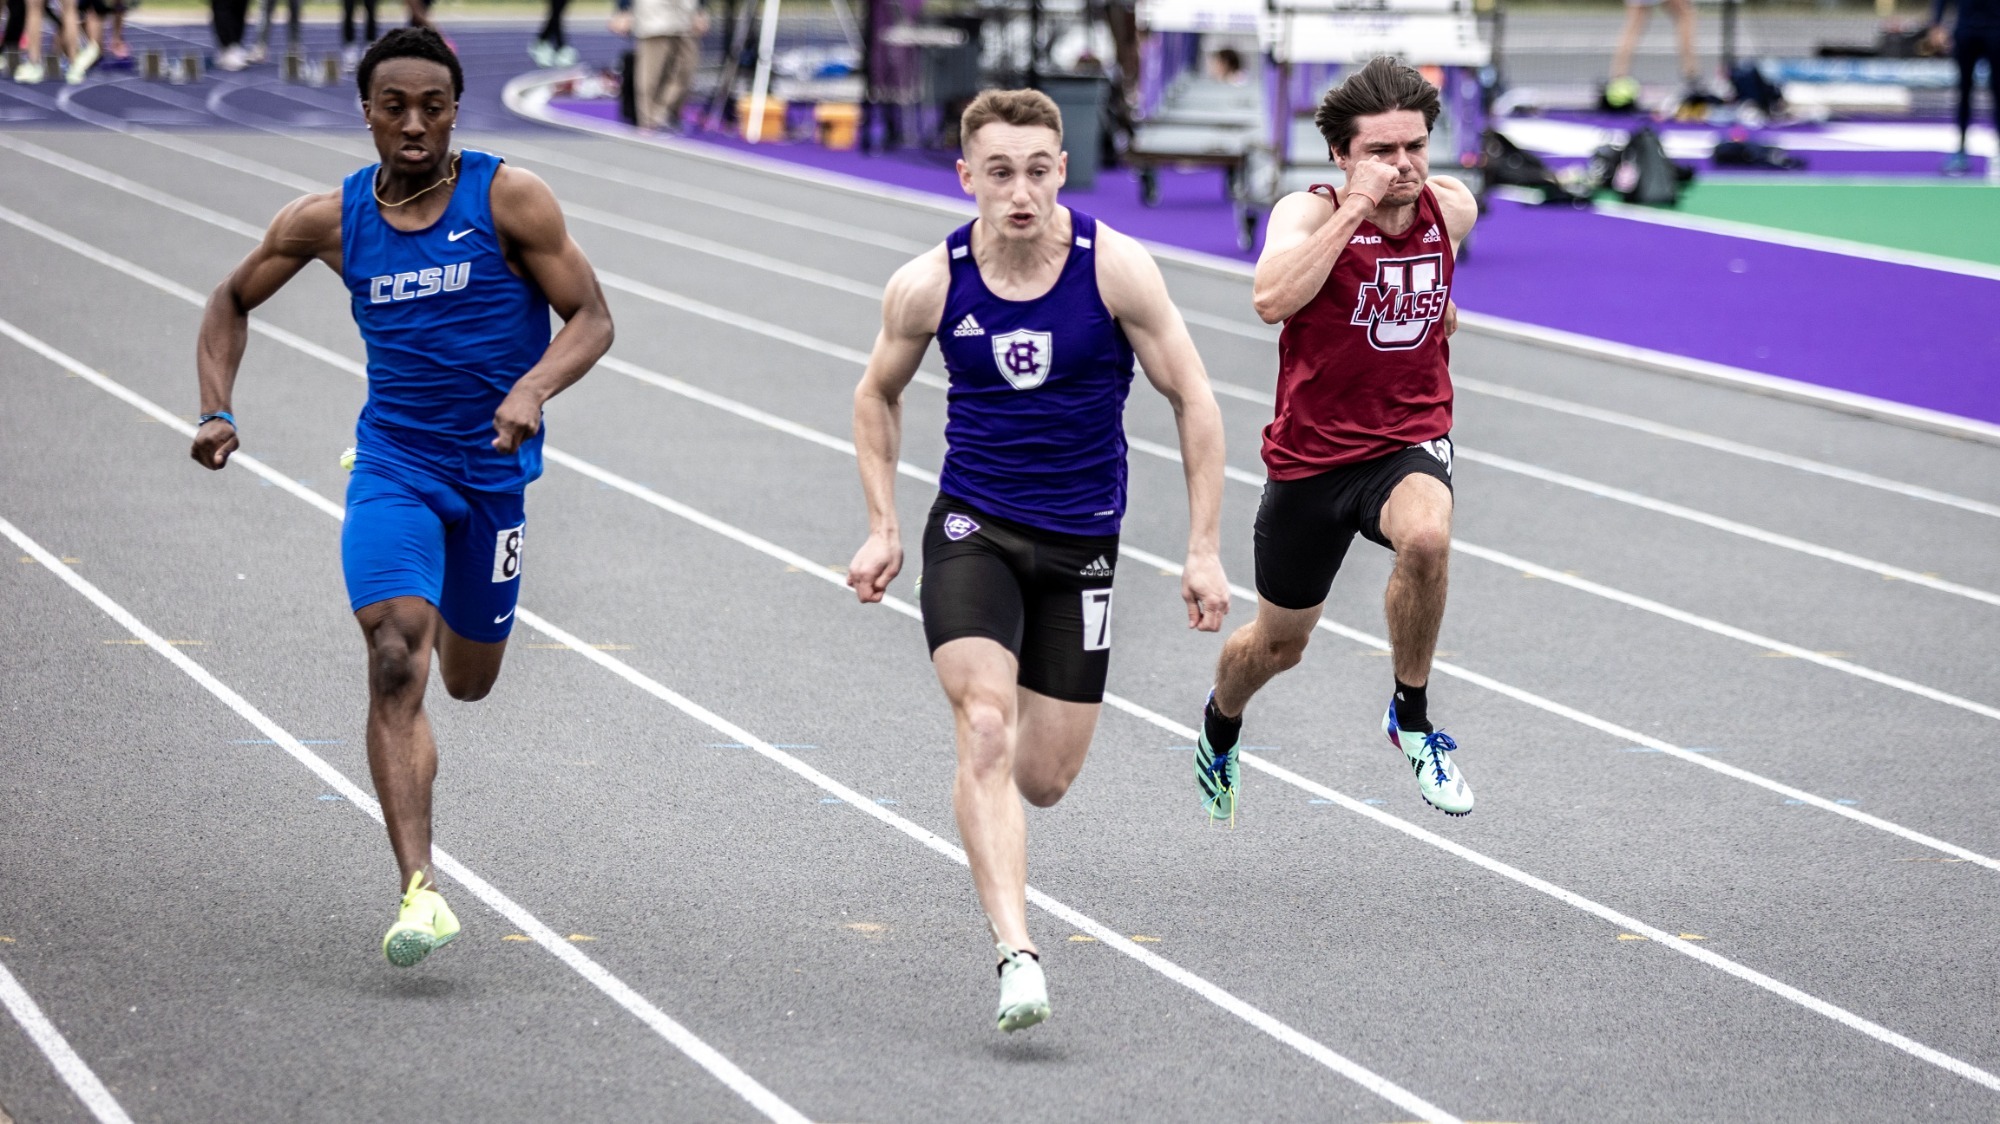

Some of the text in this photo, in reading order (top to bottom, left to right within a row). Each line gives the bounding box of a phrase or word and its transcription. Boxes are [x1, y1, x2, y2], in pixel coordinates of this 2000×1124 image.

[1422, 235, 1441, 244] adid
[370, 262, 471, 303] CCSU
[953, 328, 985, 337] adidas
[503, 530, 519, 578] 8
[1079, 568, 1114, 577] adidas
[1093, 593, 1110, 646] 7
